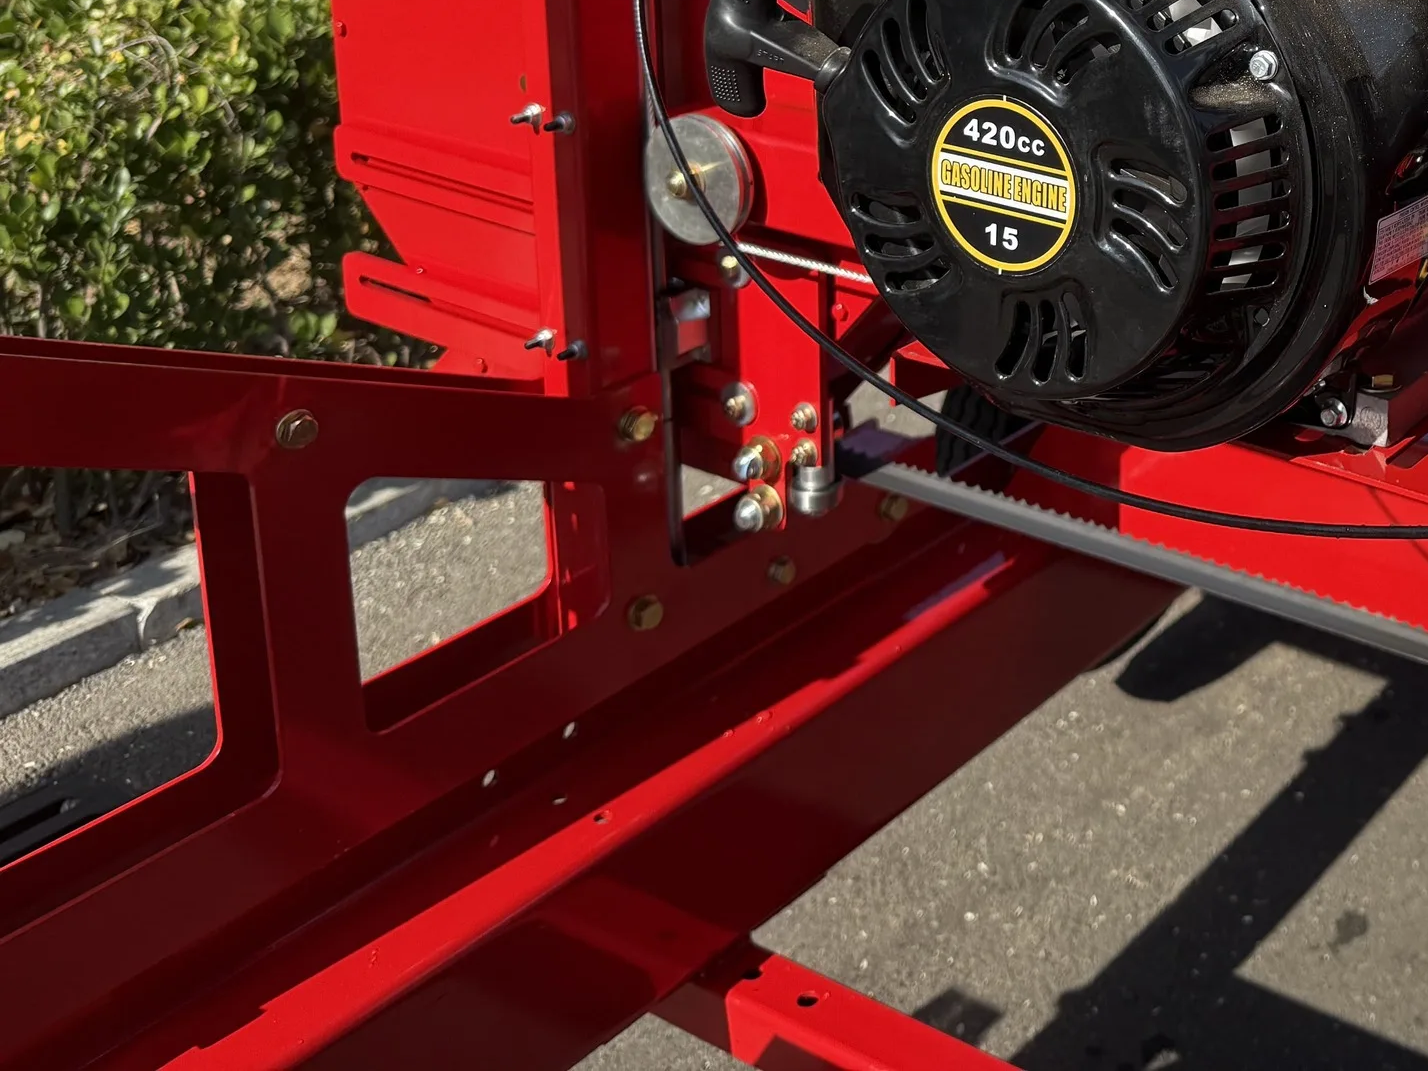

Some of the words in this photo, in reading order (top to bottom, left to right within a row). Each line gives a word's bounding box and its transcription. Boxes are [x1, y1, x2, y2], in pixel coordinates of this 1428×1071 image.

[963, 118, 1045, 157] 420cc
[941, 159, 1012, 200] GASOLINE
[1013, 175, 1068, 213] ENGINE
[984, 222, 1019, 251] 15
